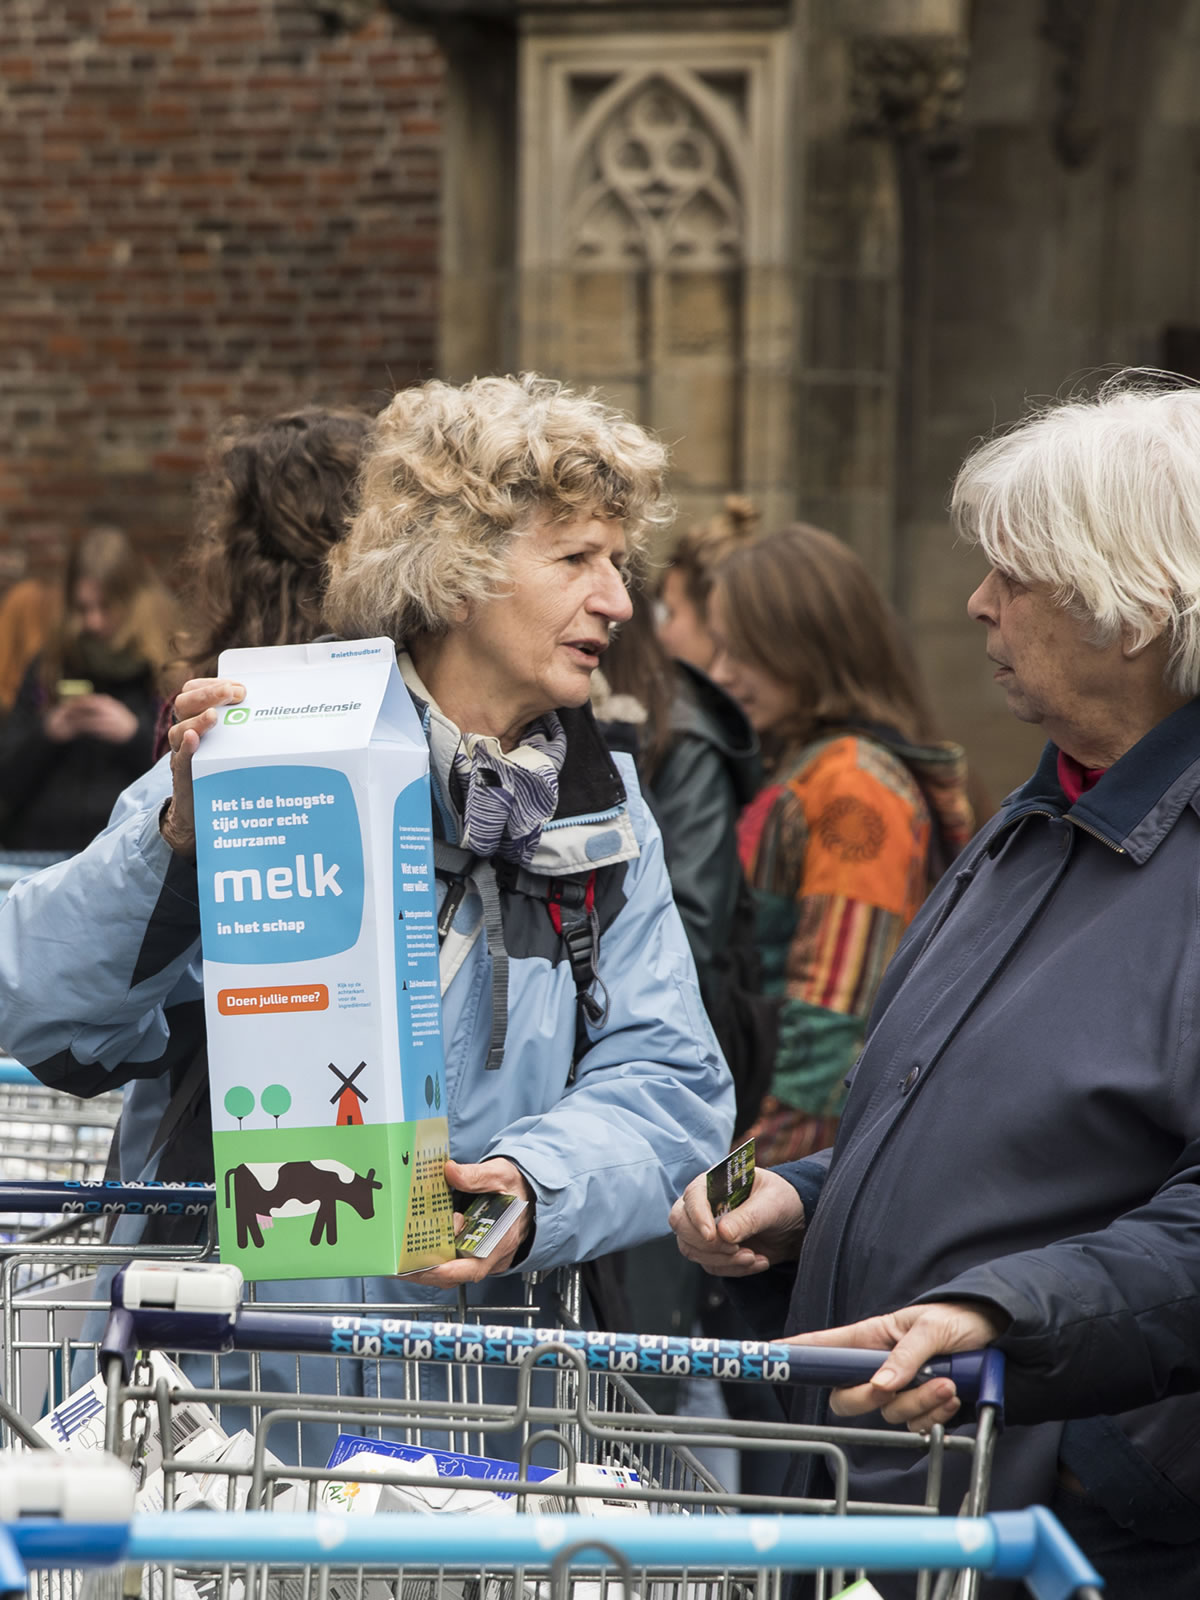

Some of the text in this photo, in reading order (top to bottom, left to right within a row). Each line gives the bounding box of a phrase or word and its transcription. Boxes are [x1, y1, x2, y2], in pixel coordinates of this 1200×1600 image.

[330, 648, 381, 659] #niethoudbaar
[254, 701, 362, 717] milieudefensie
[211, 793, 335, 812] Het is de hoogste
[212, 813, 309, 833] tijd voor echt
[213, 835, 286, 849] duurzame
[214, 853, 343, 903] melk
[217, 919, 305, 935] in het schap
[226, 991, 321, 1008] Doen jullie mee?
